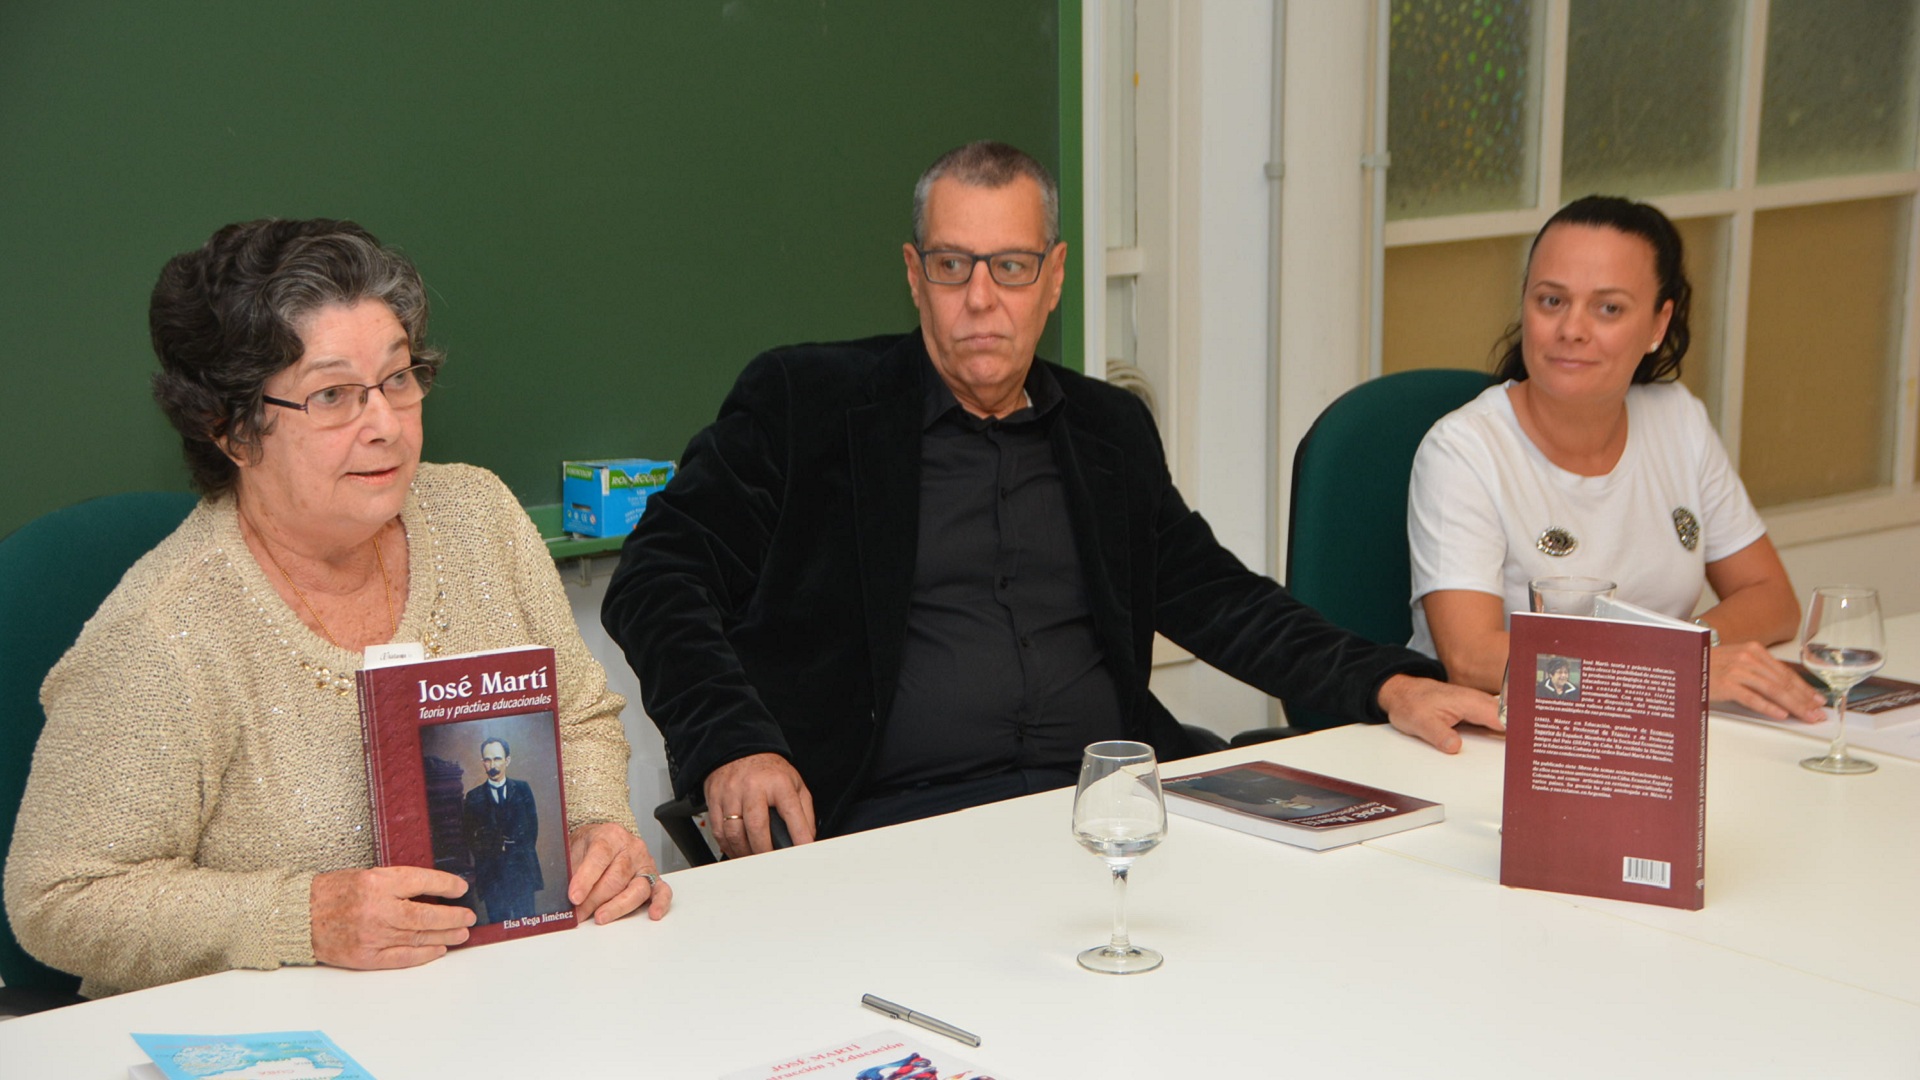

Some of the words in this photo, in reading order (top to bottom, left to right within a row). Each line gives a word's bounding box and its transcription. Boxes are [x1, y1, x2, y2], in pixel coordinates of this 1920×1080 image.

[418, 675, 472, 703] José
[480, 666, 548, 695] Martí
[419, 705, 445, 719] Teoría
[446, 706, 453, 719] y
[454, 700, 490, 718] práctica
[492, 694, 552, 710] educacionales
[503, 919, 521, 929] Elsa
[521, 916, 540, 927] Vega
[542, 910, 574, 923] Jiménez
[772, 1058, 809, 1072] JOSÉ
[809, 1043, 862, 1061] MARTÍ
[836, 1042, 905, 1064] Educación
